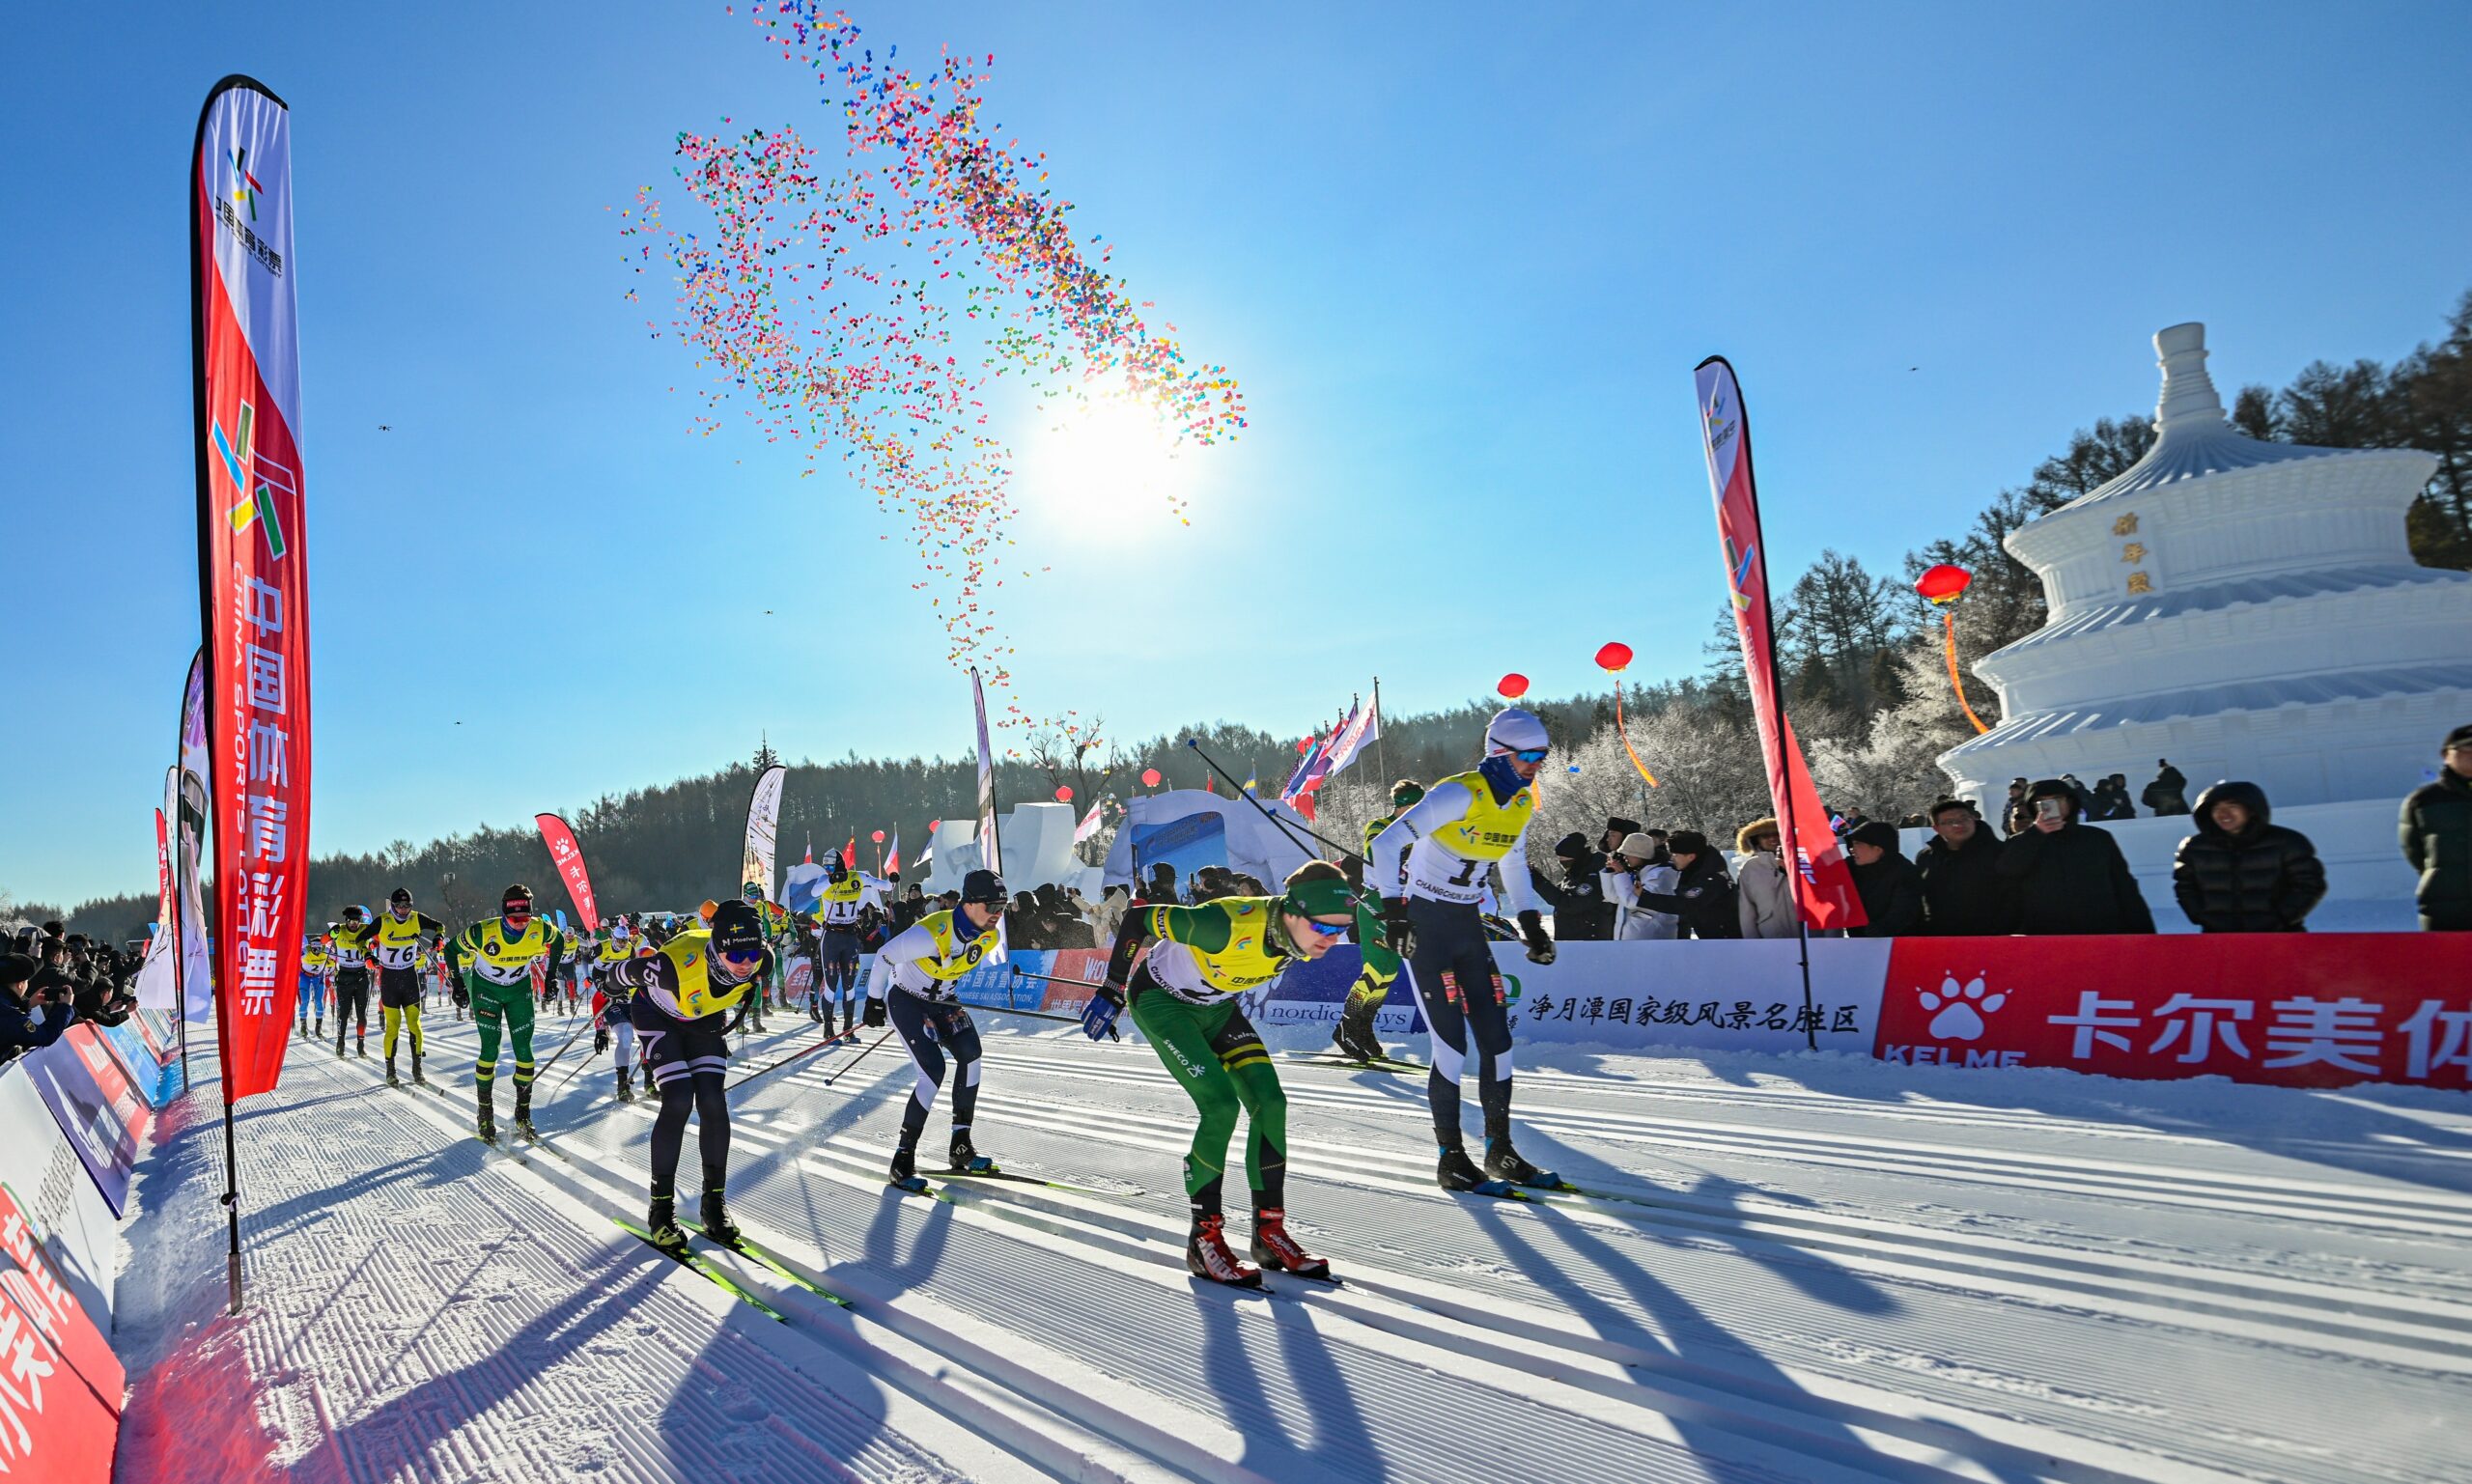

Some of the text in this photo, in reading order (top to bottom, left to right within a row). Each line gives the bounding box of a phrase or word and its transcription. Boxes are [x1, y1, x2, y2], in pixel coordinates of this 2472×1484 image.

[244, 575, 290, 1017] 中国体育彩票
[835, 901, 857, 917] 17
[386, 946, 413, 964] 76
[488, 945, 495, 954] 4
[969, 949, 977, 962] 8
[980, 993, 990, 1001] SKI
[1528, 994, 1860, 1033] 净月潭国家级风景名胜区
[2047, 991, 2472, 1079] 卡尔美体
[1163, 1039, 1189, 1066] SWECO
[1195, 1236, 1243, 1280] alpina
